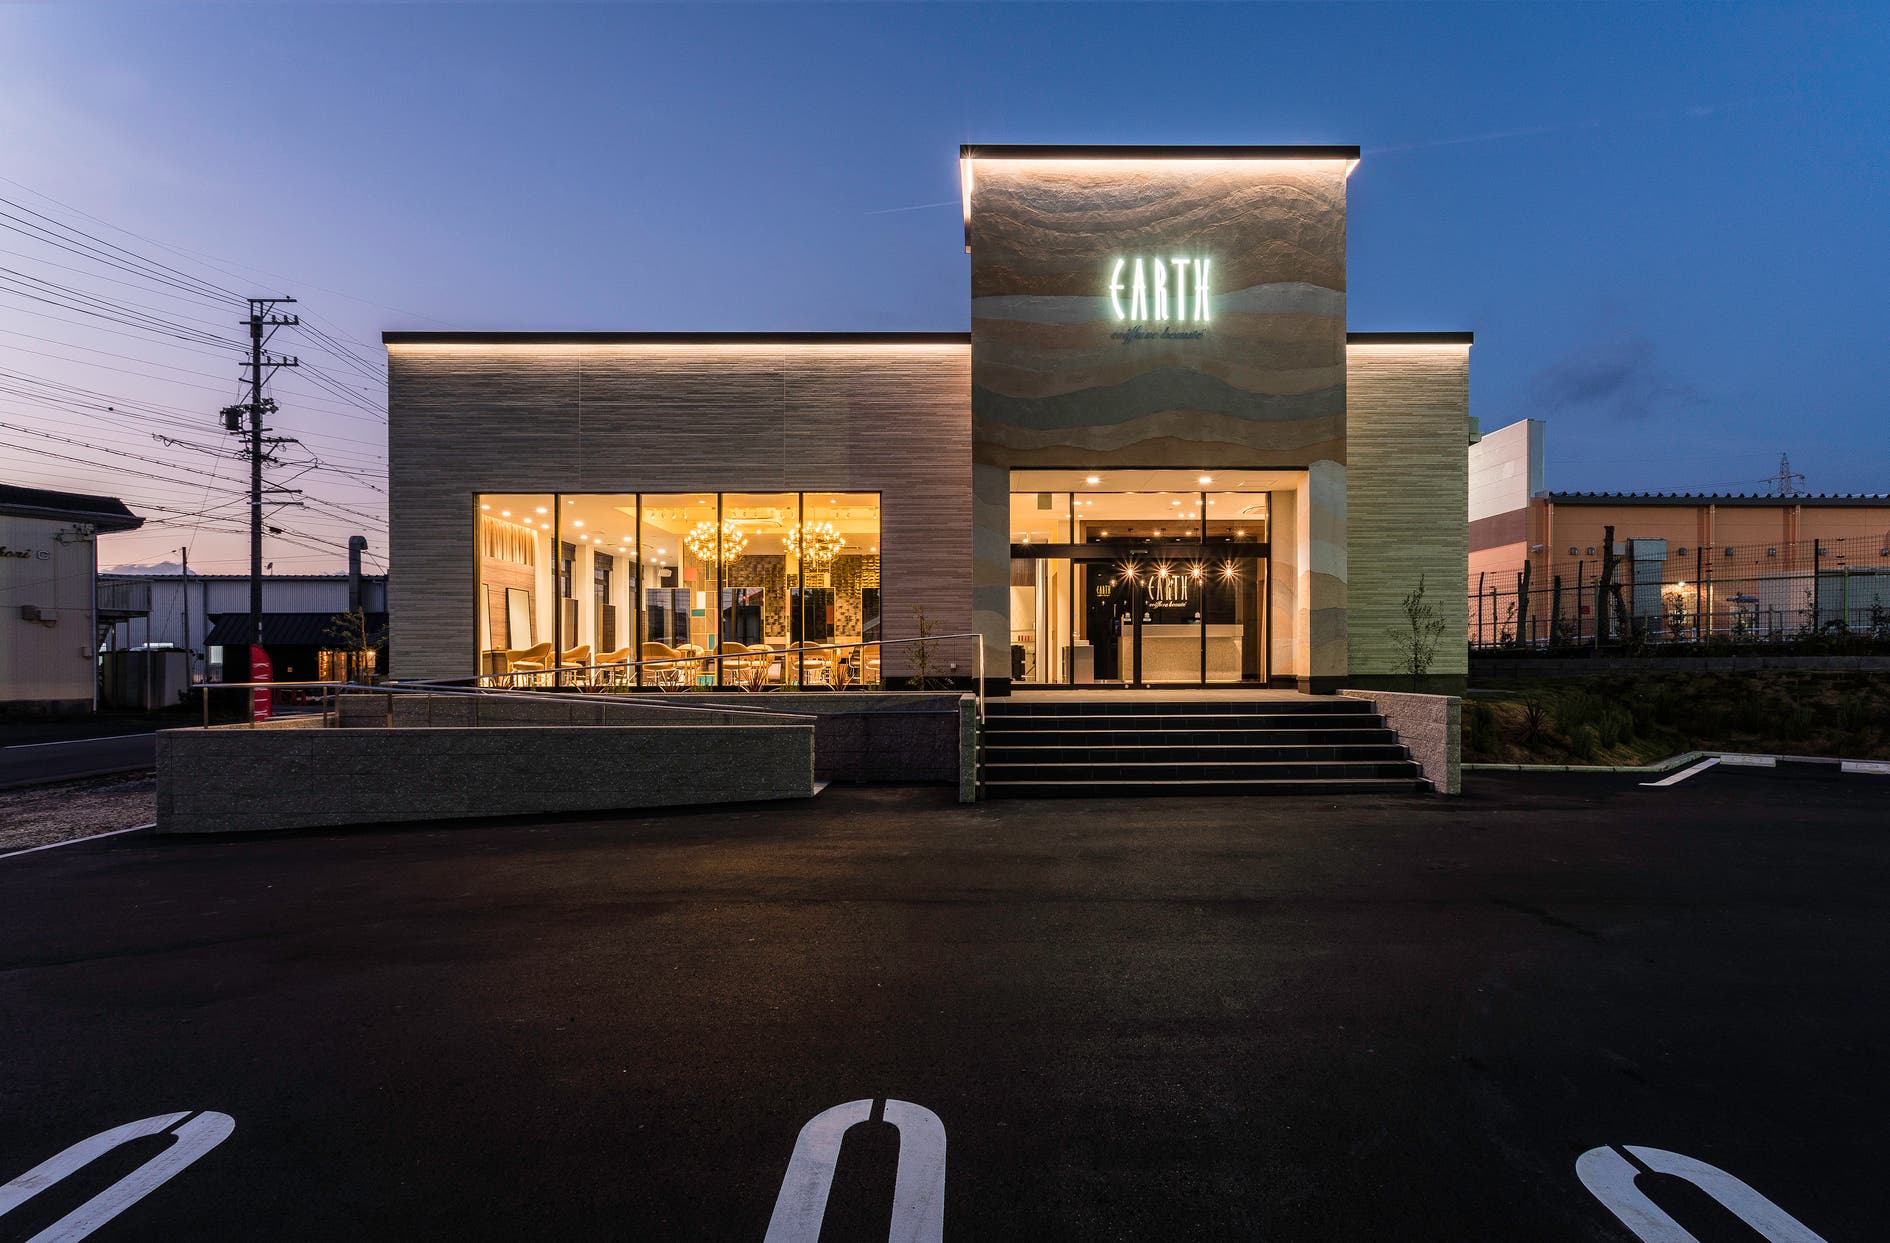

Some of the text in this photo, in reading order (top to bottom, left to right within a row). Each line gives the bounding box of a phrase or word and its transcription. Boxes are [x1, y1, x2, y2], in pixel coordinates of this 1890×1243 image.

[1109, 258, 1211, 321] EARTH
[1096, 585, 1111, 595] EARTH
[1148, 575, 1188, 601] EARTH
